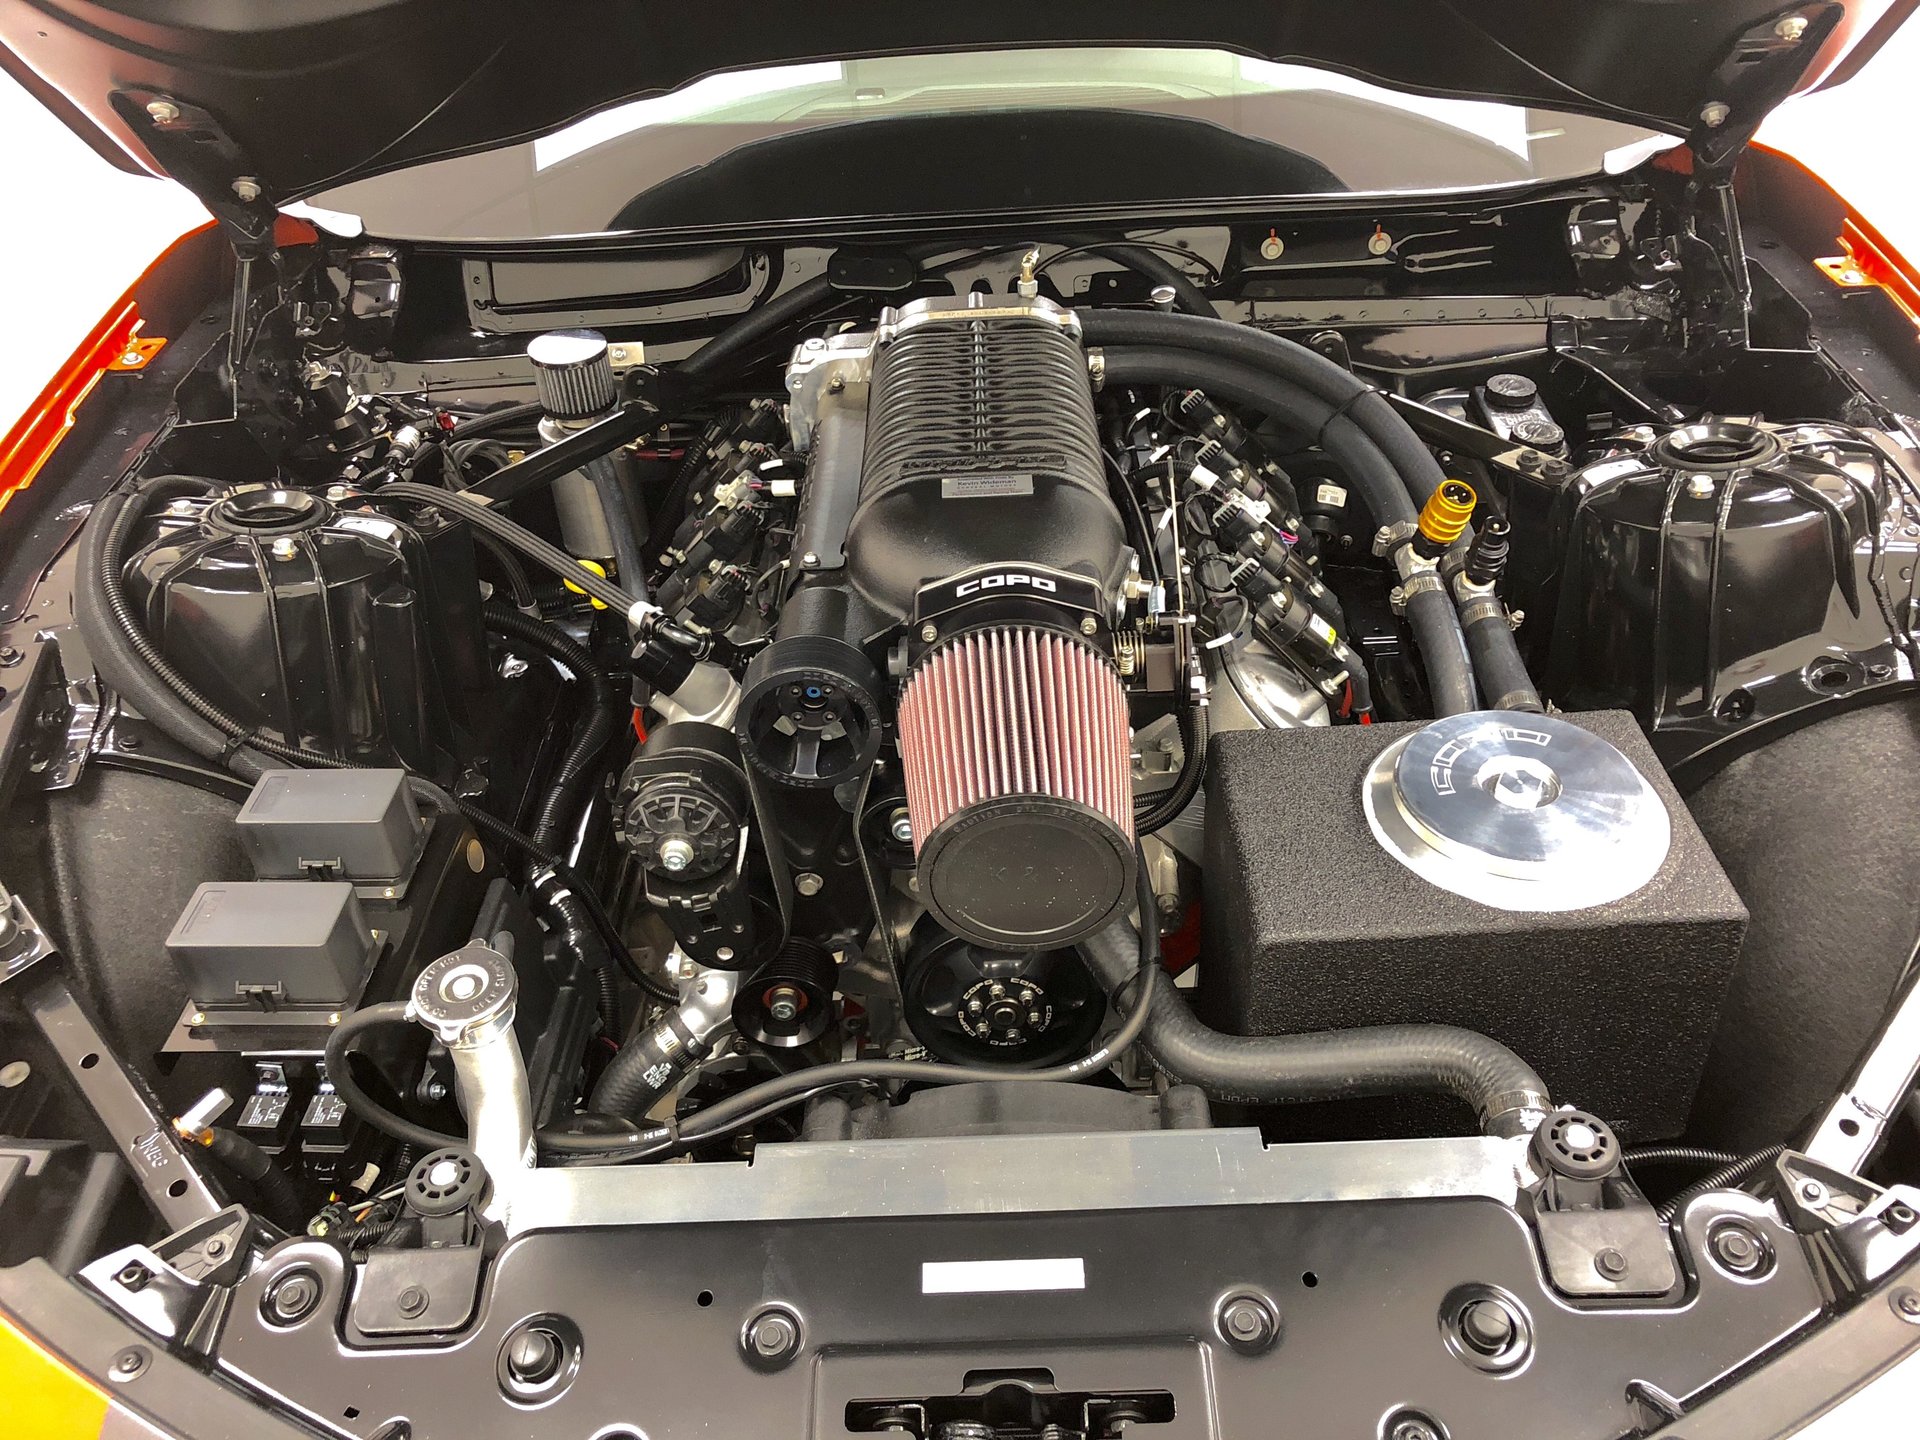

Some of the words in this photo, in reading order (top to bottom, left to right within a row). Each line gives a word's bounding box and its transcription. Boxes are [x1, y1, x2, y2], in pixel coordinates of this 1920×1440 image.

[956, 574, 1056, 598] COPO
[1430, 727, 1552, 796] COO
[962, 979, 994, 1000] COPO
[1010, 978, 1044, 995] COPO
[958, 1011, 976, 1037] COPO
[1038, 1005, 1052, 1032] COPO
[650, 1064, 668, 1084] ENG
[659, 1062, 670, 1076] V8
[642, 1071, 662, 1090] LWR
